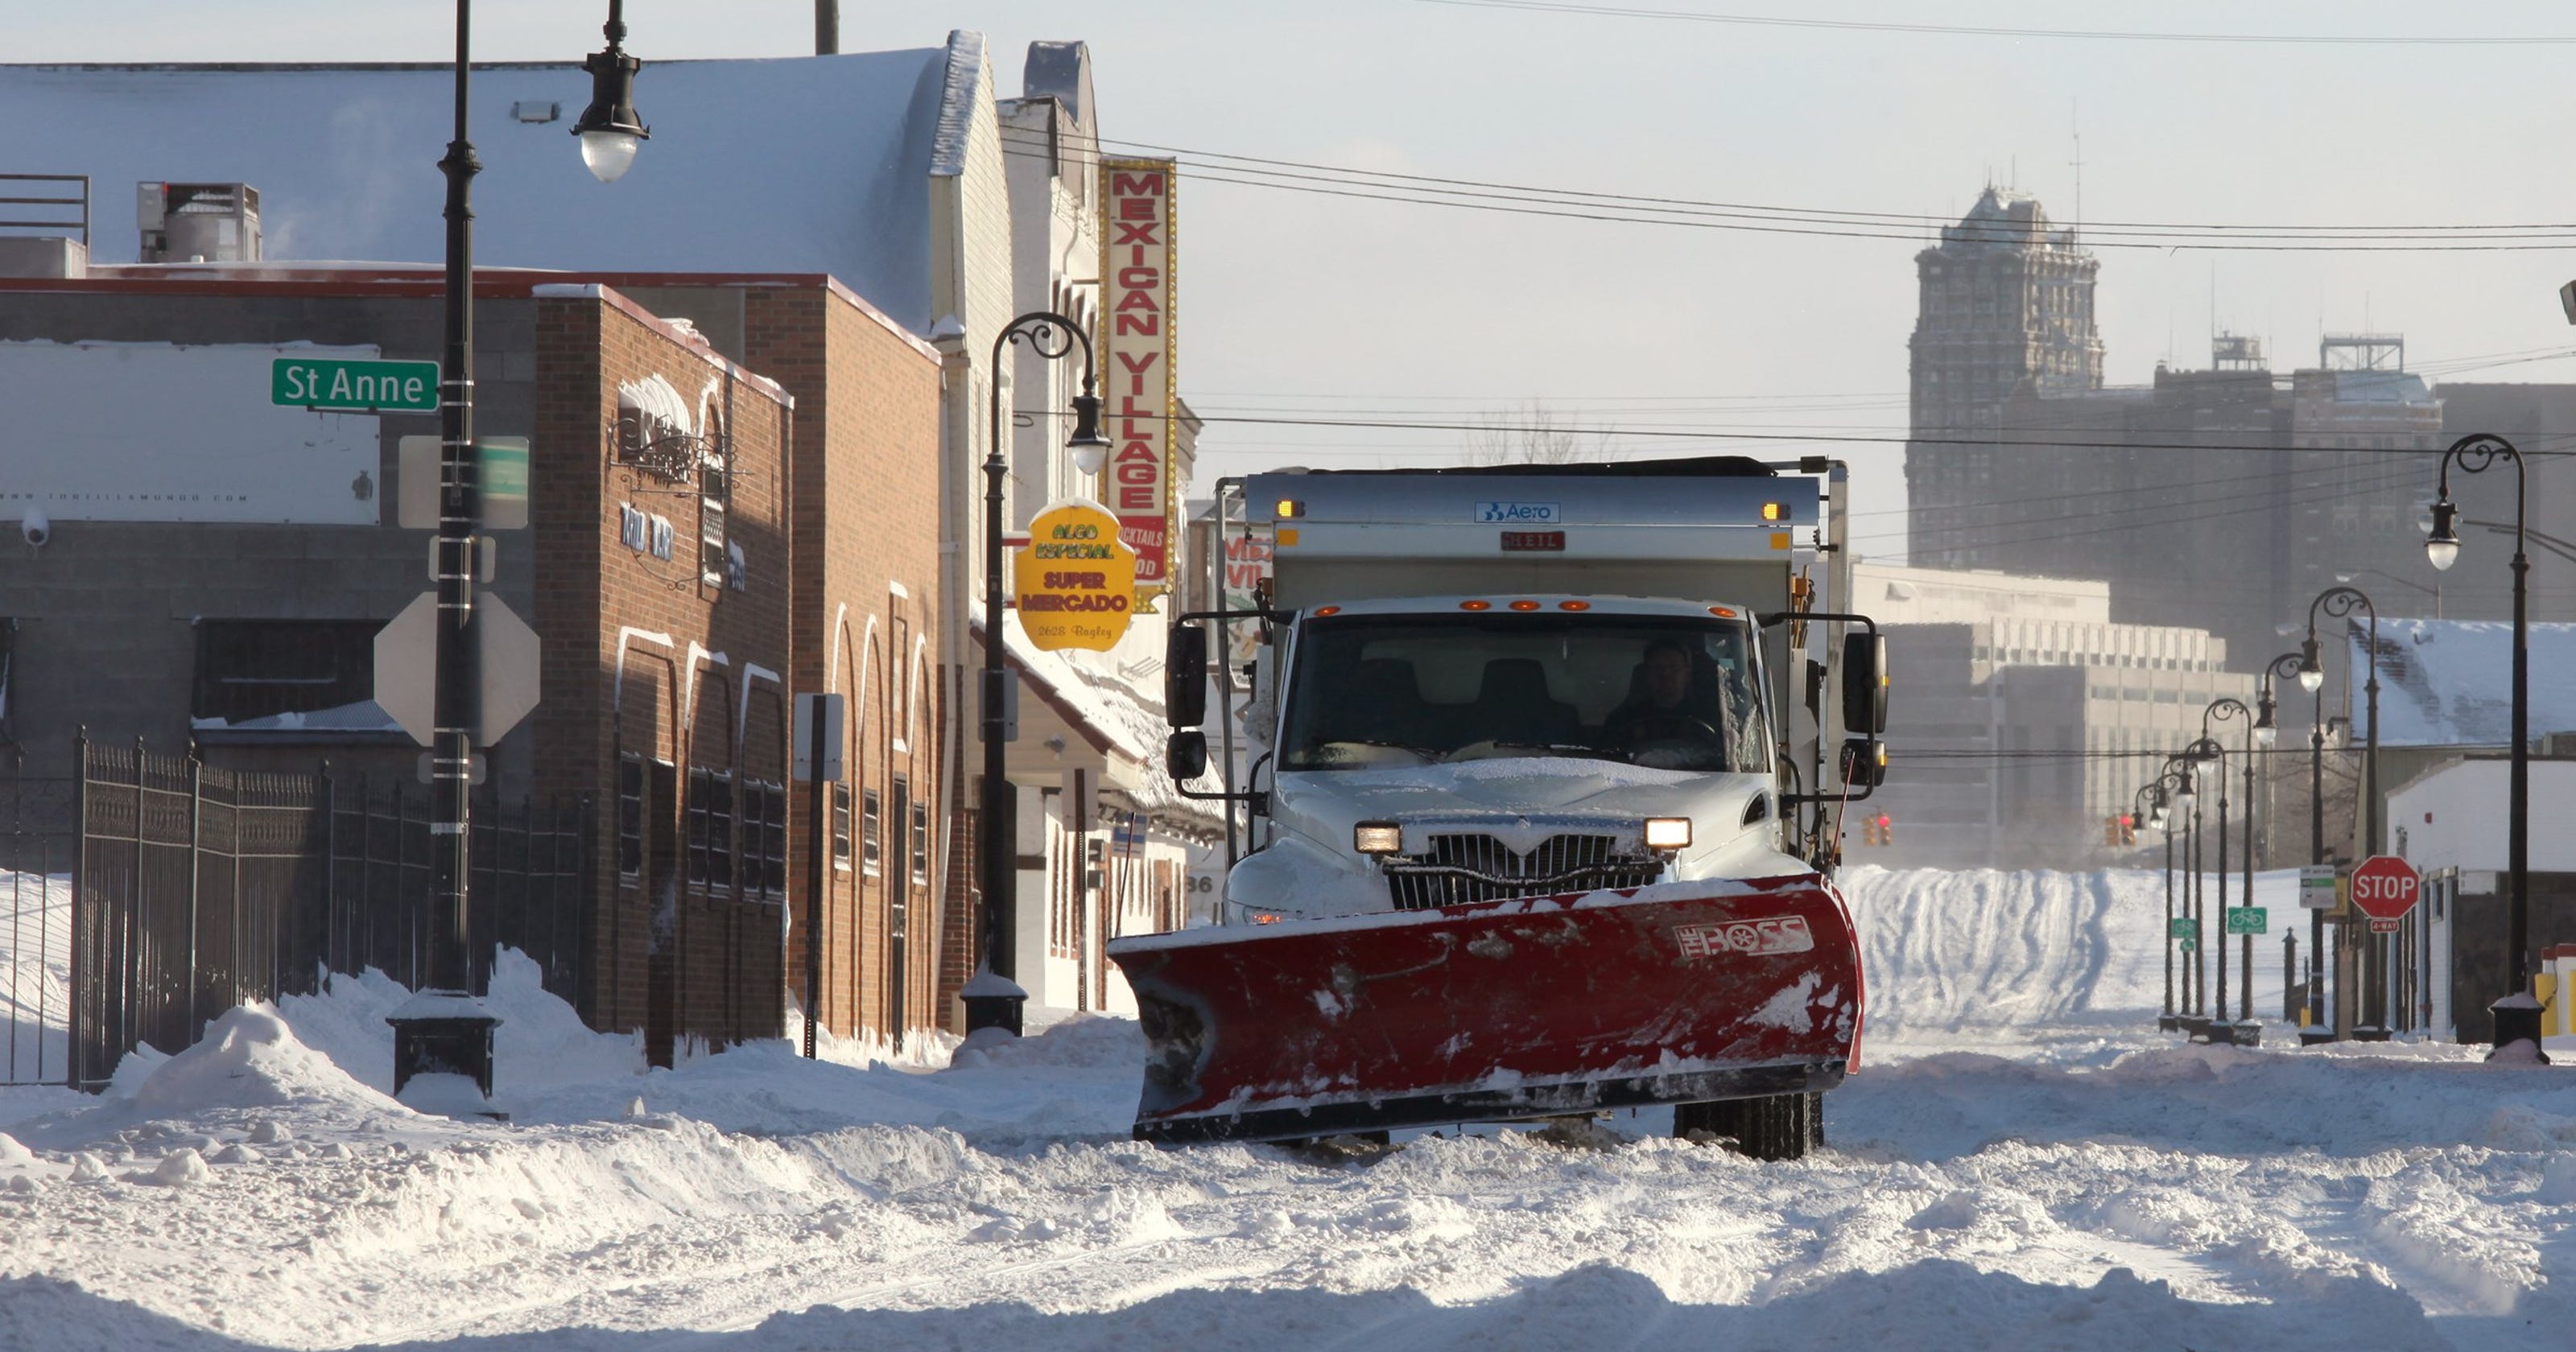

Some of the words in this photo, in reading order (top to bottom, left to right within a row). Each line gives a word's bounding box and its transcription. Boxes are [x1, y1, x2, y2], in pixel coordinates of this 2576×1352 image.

[1113, 173, 1163, 336] MEXICAN
[285, 365, 319, 399] St
[328, 367, 423, 402] Anne
[1114, 352, 1160, 509] VILLAGE
[1505, 504, 1551, 519] Aero
[1052, 524, 1098, 539] ALGO
[1119, 527, 1164, 547] OCKTAILS
[1035, 543, 1114, 559] ESPECIAL
[1136, 559, 1157, 576] OD
[1043, 571, 1107, 589] SUPER
[1022, 594, 1128, 612] MERCADO
[1038, 625, 1067, 637] 2628
[1072, 624, 1112, 639] Bagley
[2356, 875, 2415, 900] STOP
[2372, 921, 2397, 930] 4-WAY
[1680, 927, 1701, 958] THE
[1697, 918, 1808, 955] BOSS
